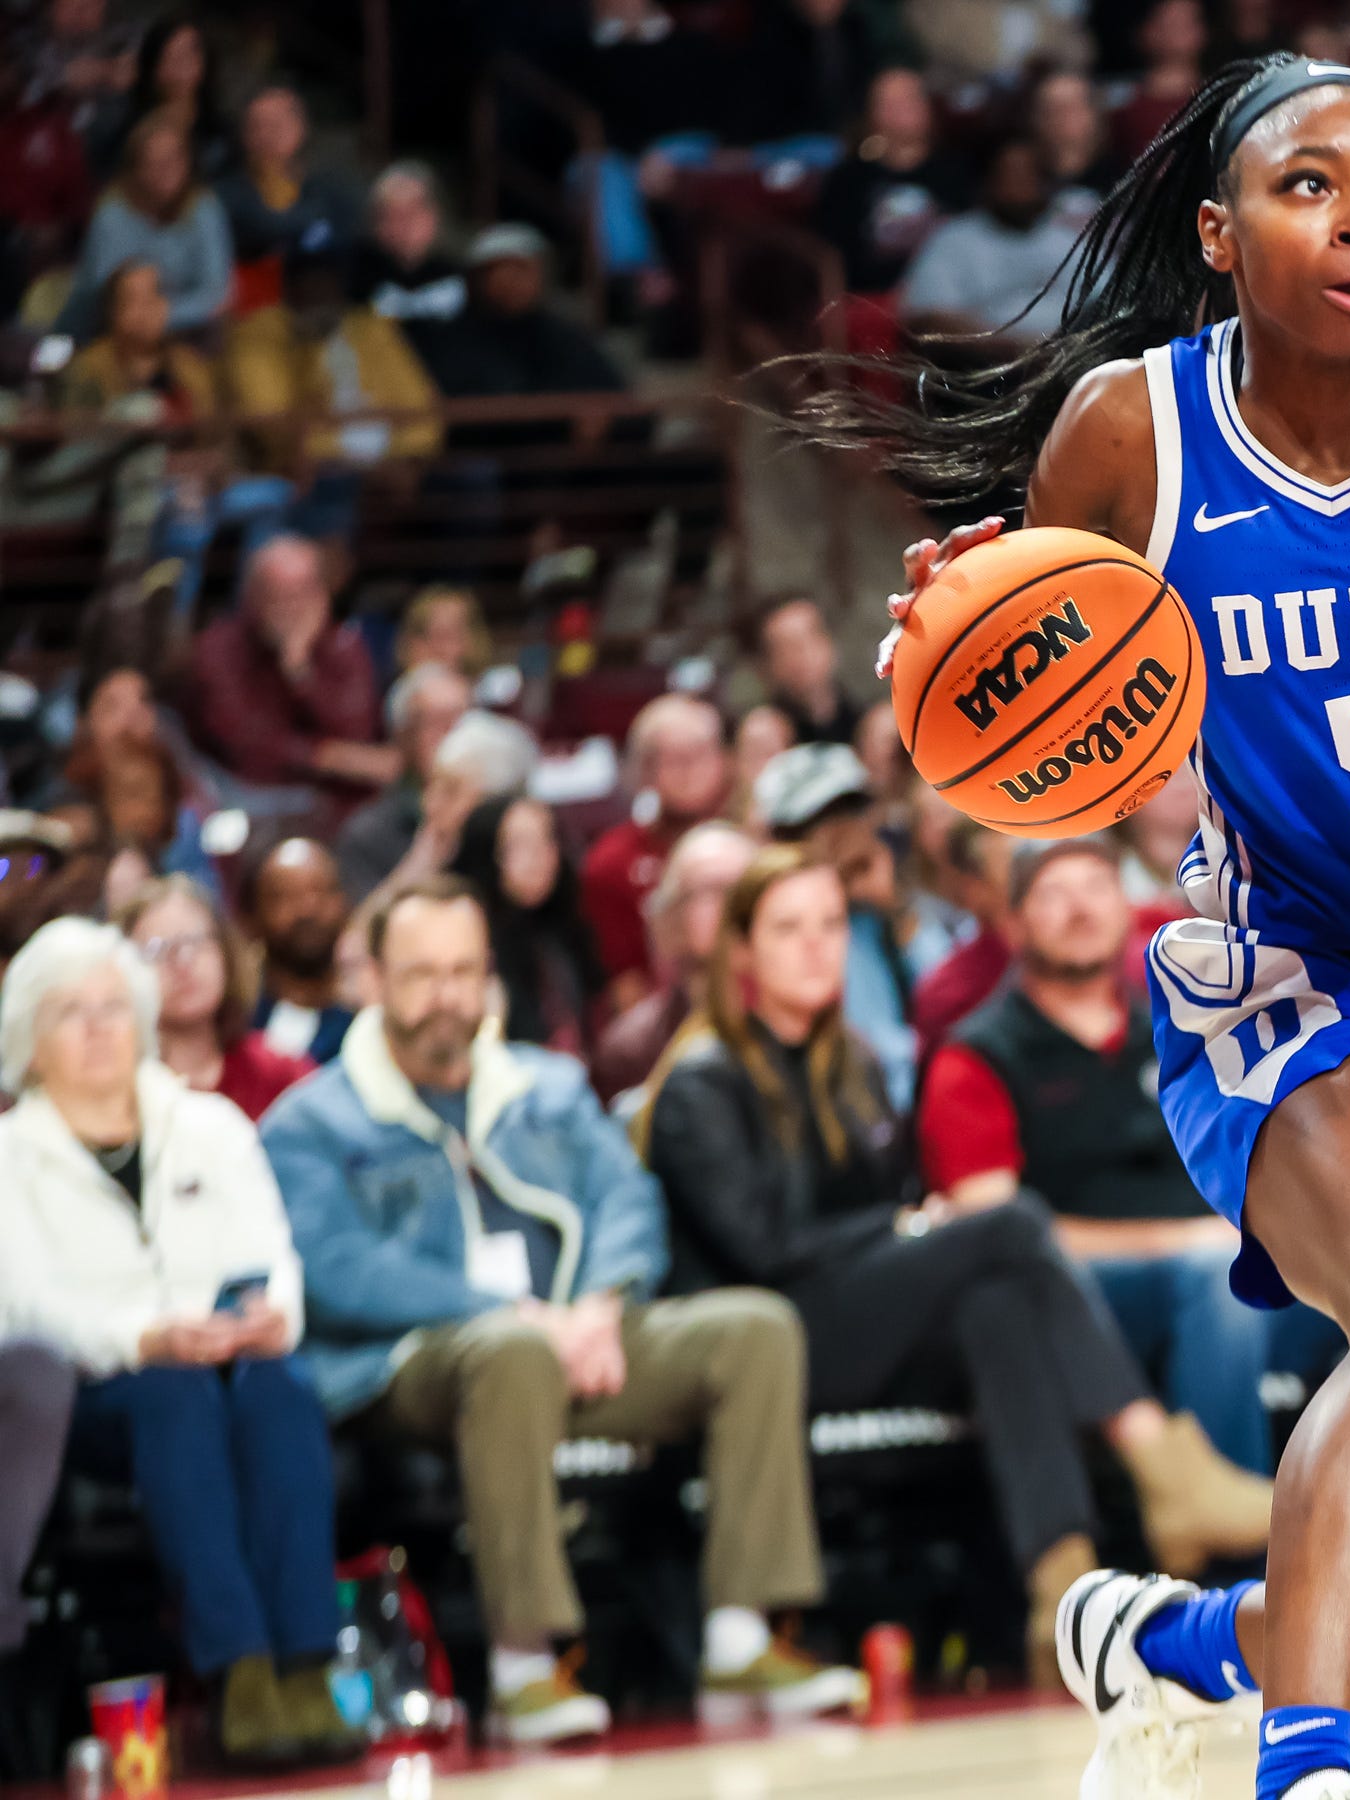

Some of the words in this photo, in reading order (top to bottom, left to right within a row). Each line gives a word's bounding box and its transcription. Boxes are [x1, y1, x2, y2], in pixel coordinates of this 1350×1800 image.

[978, 631, 1012, 663] GAME
[949, 664, 977, 693] BALL
[954, 597, 1093, 733] NCAA
[998, 656, 1177, 804] Wilson
[1058, 718, 1083, 741] GAME
[1033, 740, 1057, 757] BALL
